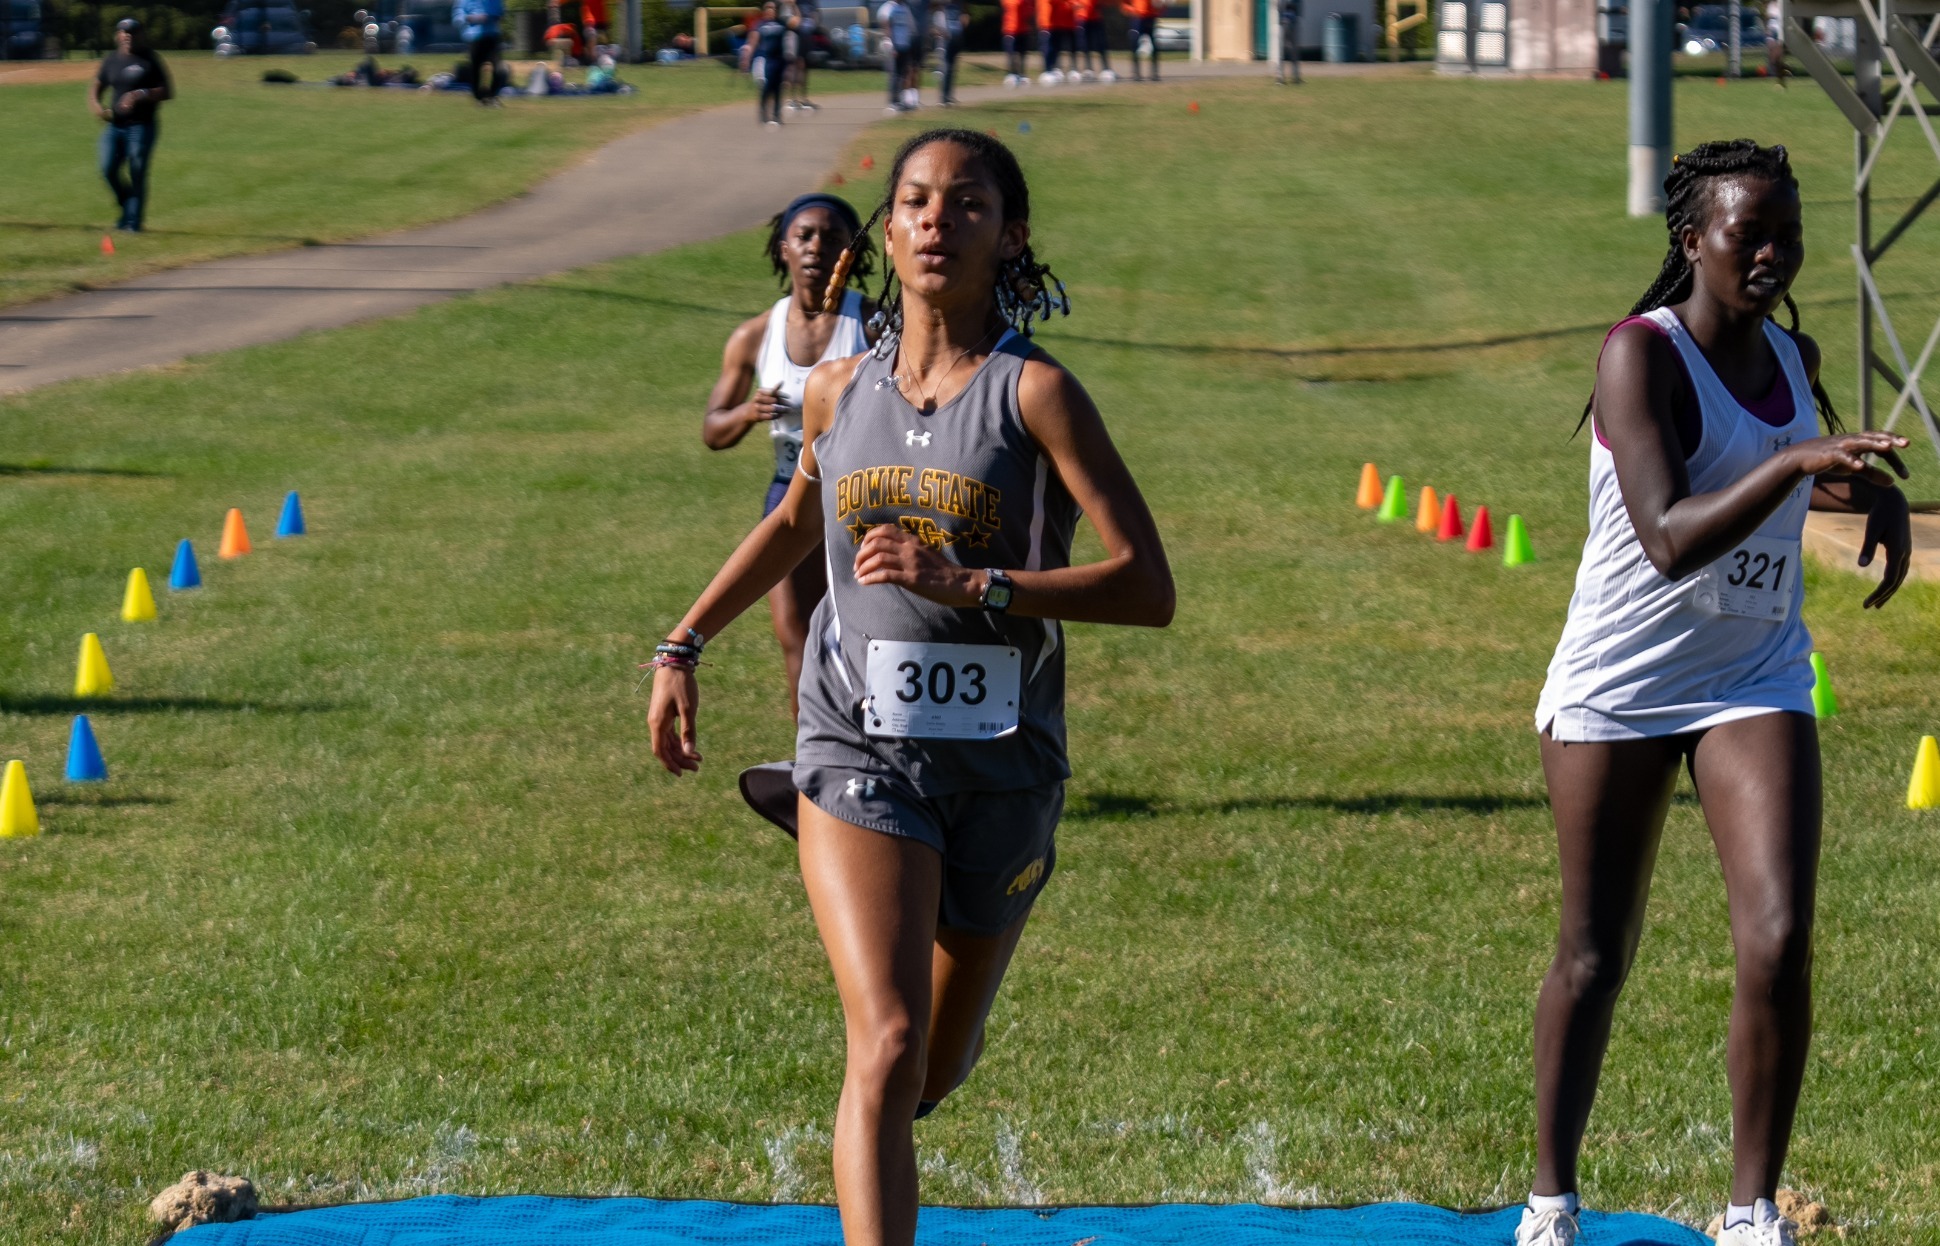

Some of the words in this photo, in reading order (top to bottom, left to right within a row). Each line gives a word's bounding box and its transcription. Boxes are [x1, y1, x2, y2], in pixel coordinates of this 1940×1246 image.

[784, 441, 803, 462] 3
[837, 466, 914, 521] BOWIE
[918, 468, 1001, 529] STATE
[1727, 549, 1787, 591] 321
[895, 660, 987, 705] 303
